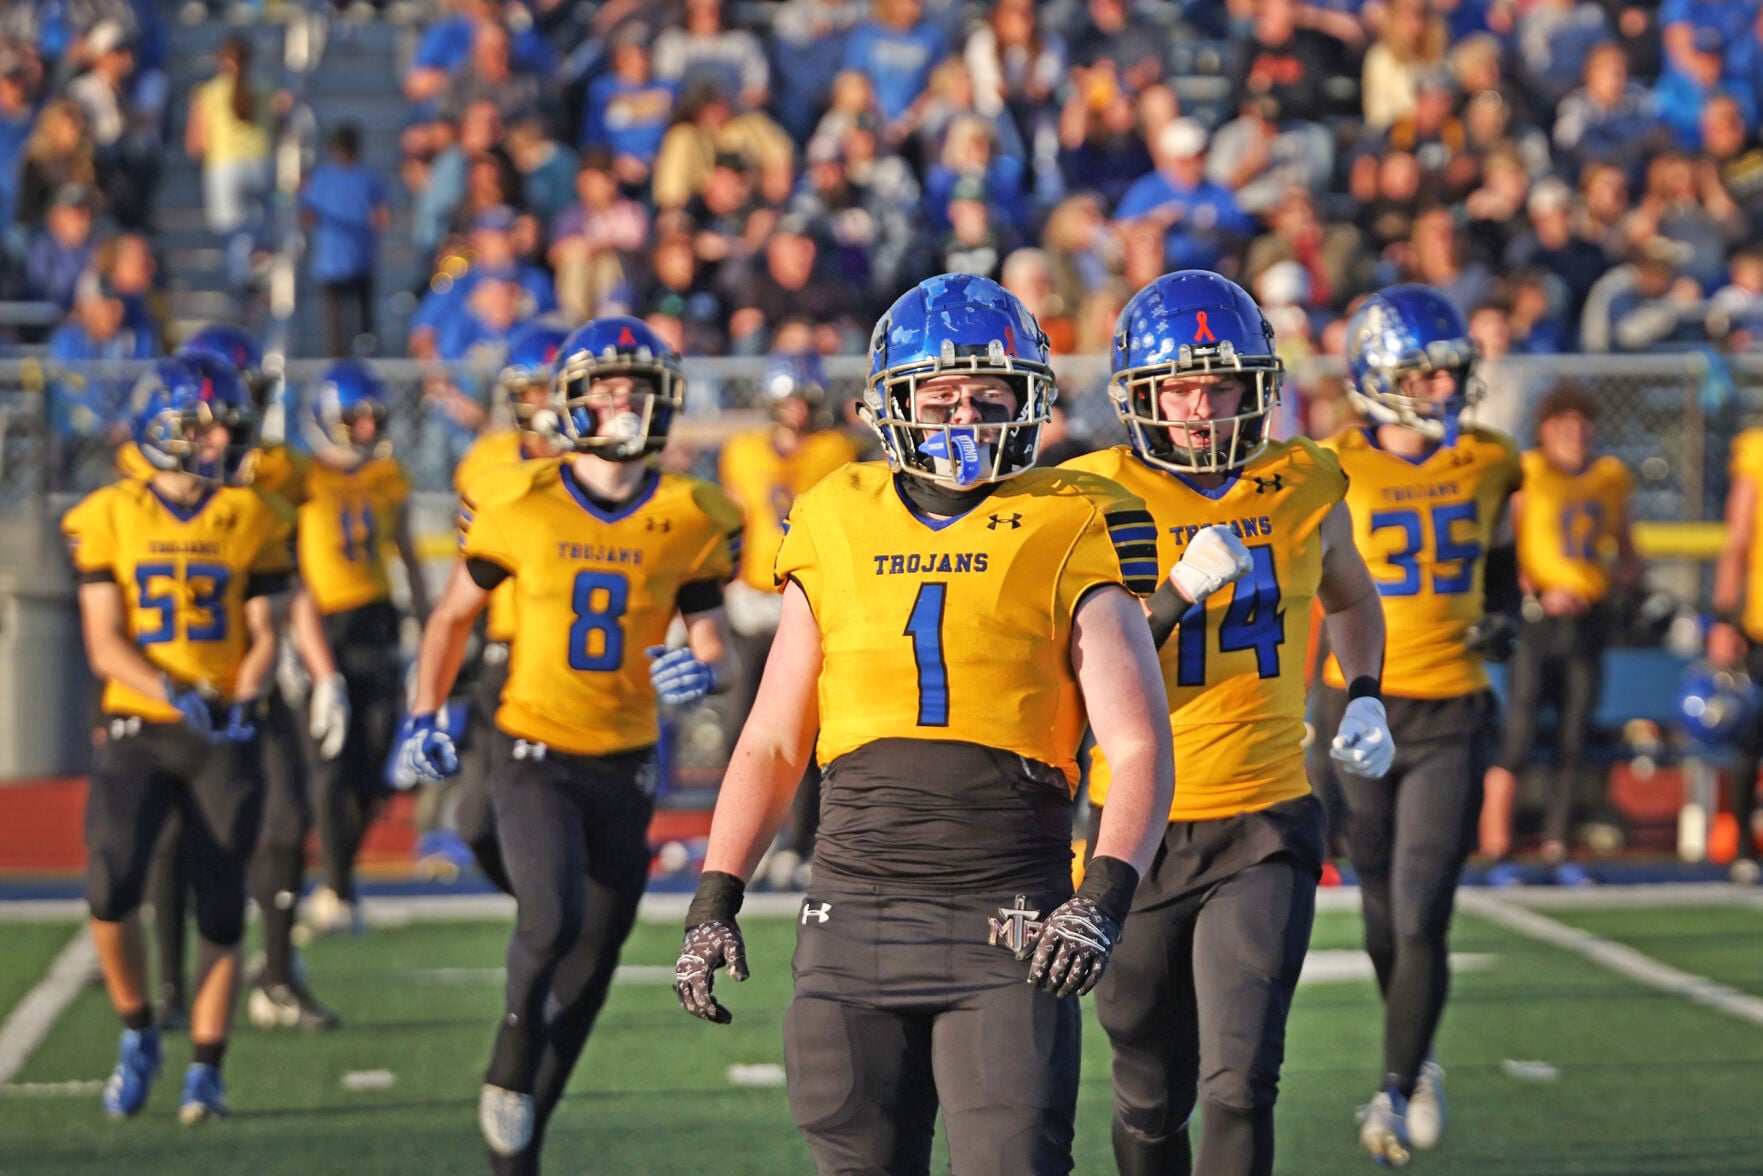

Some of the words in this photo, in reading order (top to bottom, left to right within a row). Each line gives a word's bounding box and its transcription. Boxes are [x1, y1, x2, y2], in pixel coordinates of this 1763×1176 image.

[557, 541, 644, 566] TROJANS
[873, 552, 989, 576] TROJANS
[1370, 500, 1480, 597] 35
[135, 562, 230, 642] 53
[568, 568, 630, 672] 8
[1177, 543, 1286, 687] 14
[902, 581, 950, 728] 1
